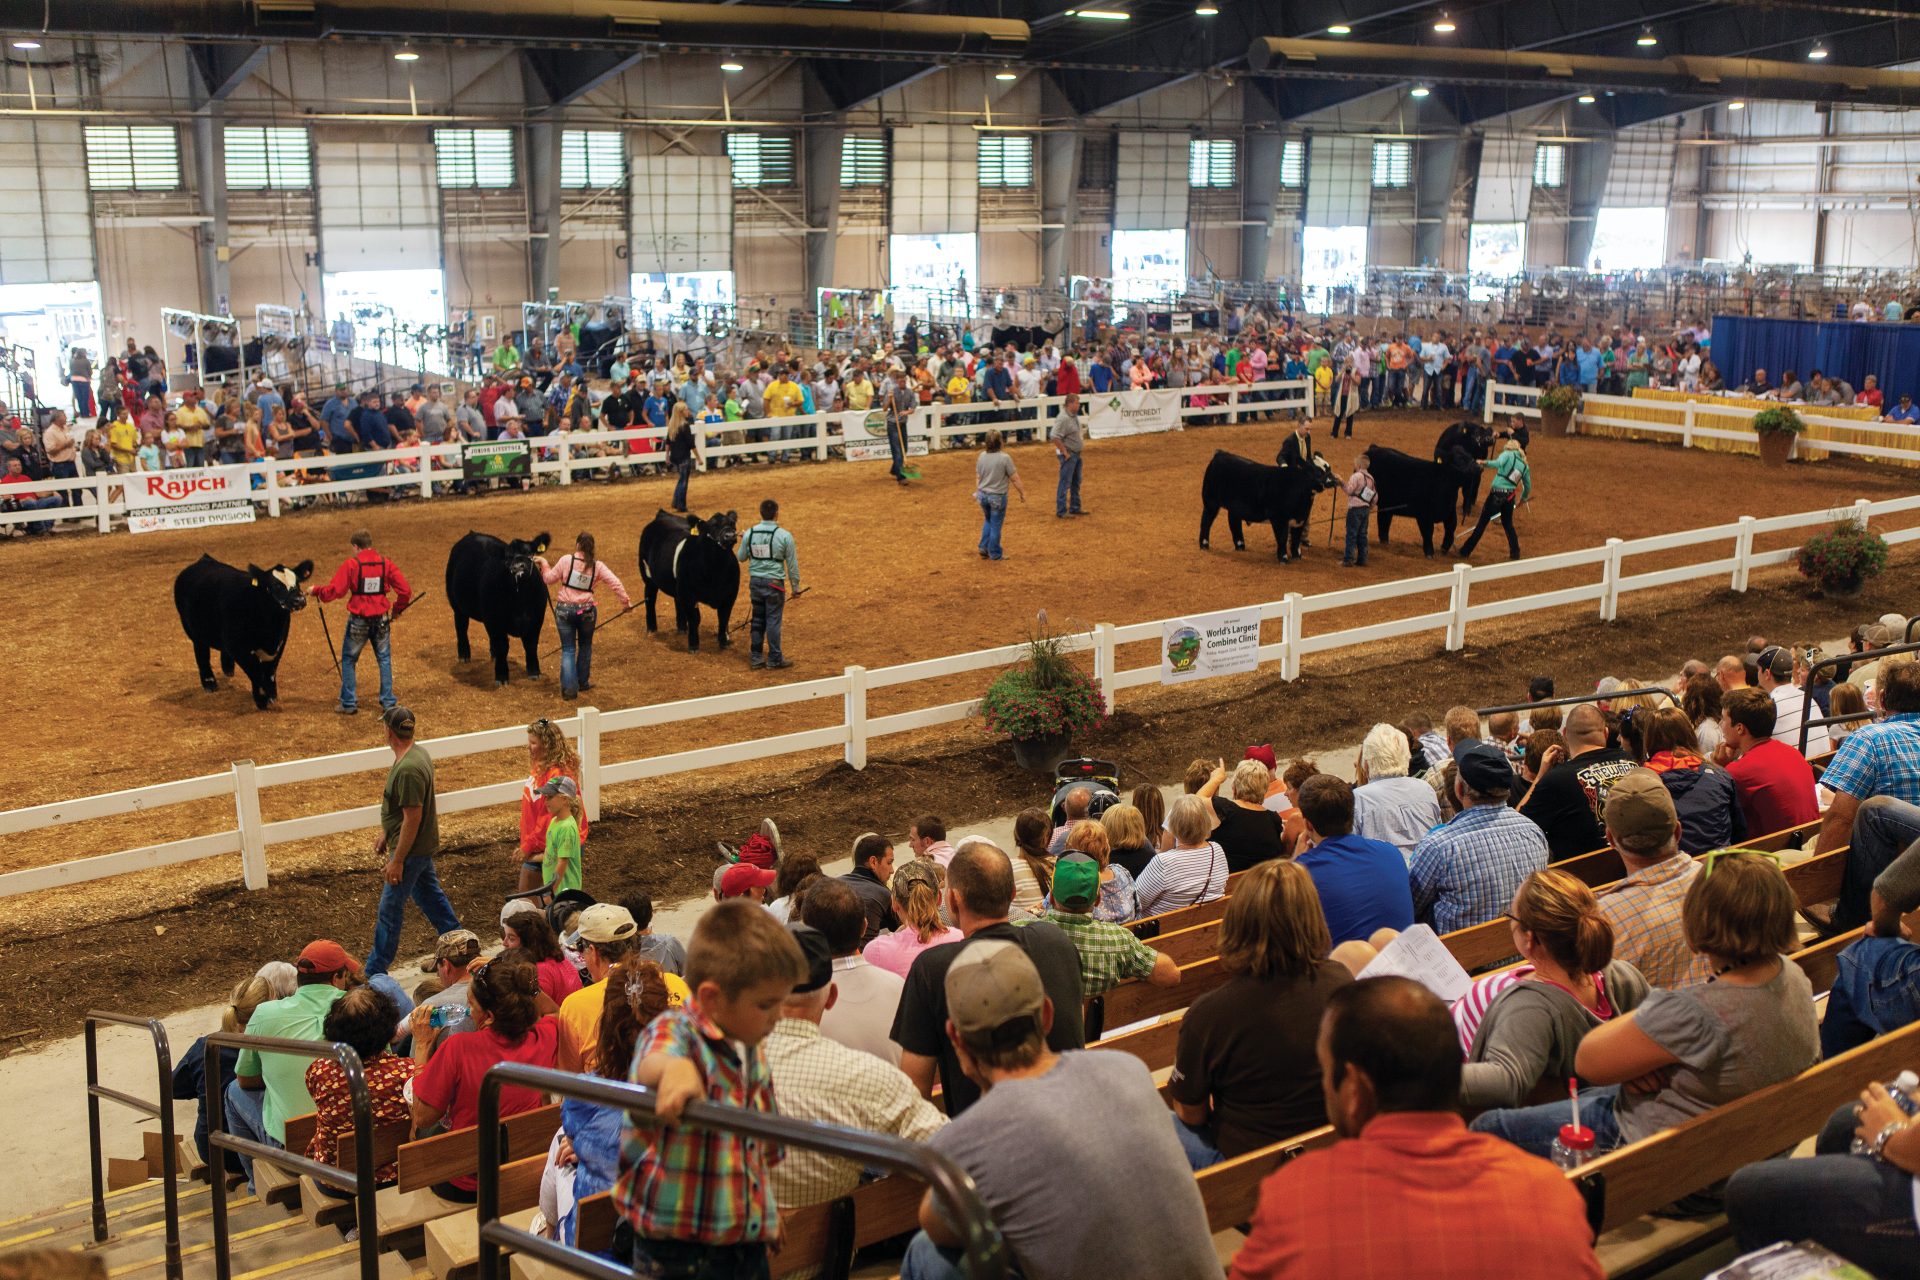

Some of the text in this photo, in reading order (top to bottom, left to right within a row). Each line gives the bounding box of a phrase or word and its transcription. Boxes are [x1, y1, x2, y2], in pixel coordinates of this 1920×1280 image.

[615, 245, 627, 260] G
[877, 240, 885, 252] F
[305, 252, 320, 267] H
[146, 476, 225, 500] RAUCH
[130, 500, 247, 517] PROUD SPONSORING PARTNER
[173, 516, 205, 526] STEER
[208, 511, 251, 523] DIVISION
[367, 582, 377, 590] 27
[1206, 626, 1231, 638] World's
[1232, 622, 1258, 634] Largest
[1207, 633, 1257, 648] Combine Clinic
[1177, 658, 1189, 666] JD
